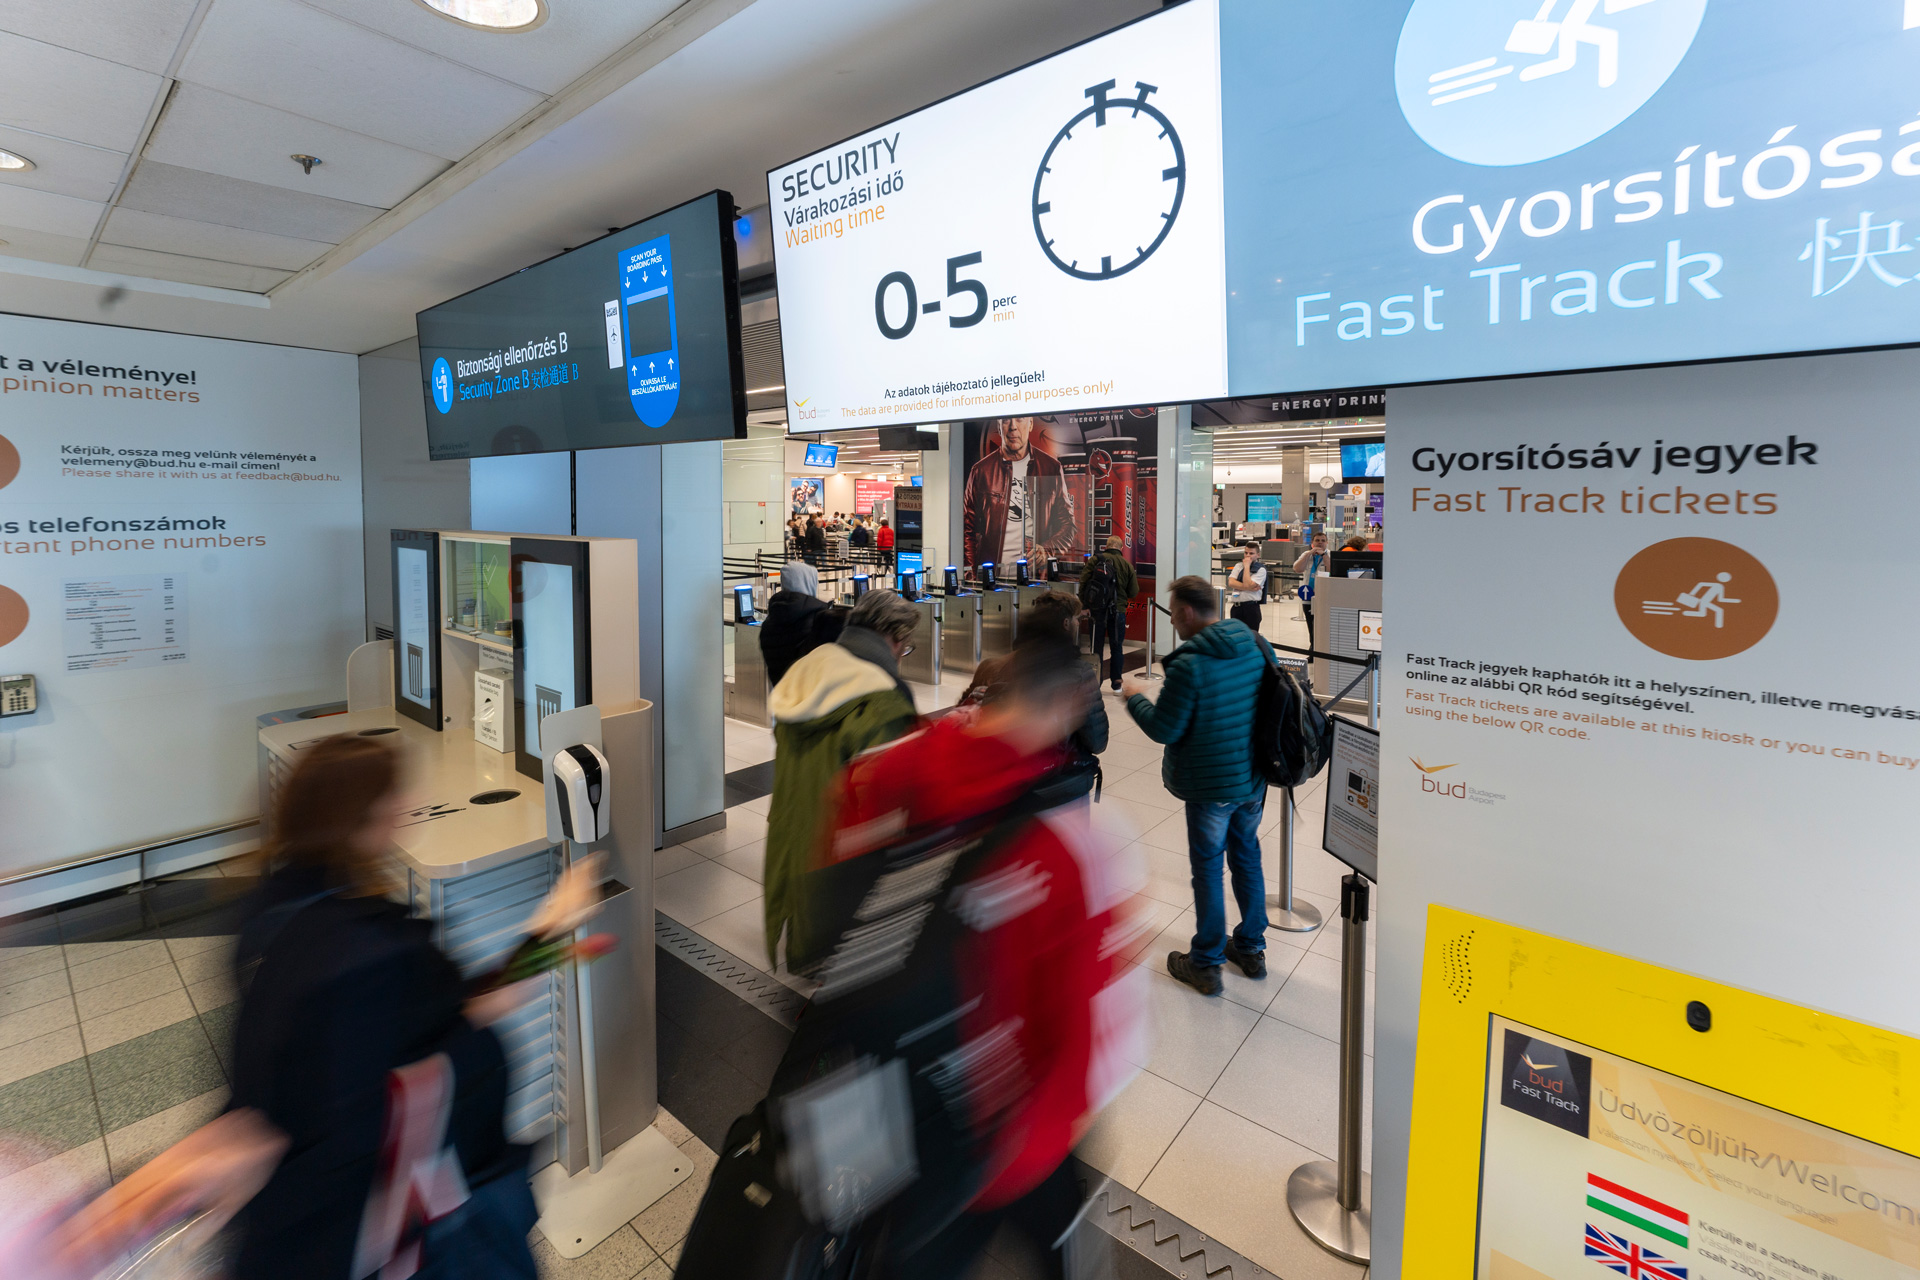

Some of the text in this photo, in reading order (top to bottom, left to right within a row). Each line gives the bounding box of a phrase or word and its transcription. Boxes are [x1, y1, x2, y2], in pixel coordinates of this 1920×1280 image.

[782, 132, 901, 202] SECURITY
[784, 170, 905, 228] Várakozási idő
[785, 203, 885, 249] Waiting time
[627, 254, 662, 273] BOARDING PASS
[630, 248, 657, 264] SCAN YOUR
[1797, 210, 1920, 298] 快
[875, 250, 989, 340] 0-5
[992, 293, 1017, 311] perc
[1295, 239, 1723, 346] Fast Track
[993, 308, 1015, 323] min
[457, 331, 568, 378] Biztonsági ellenőrzés B
[18, 359, 34, 371] a
[42, 359, 197, 386] véleménye!
[459, 363, 579, 401] Security Zone B 安检通道 B
[640, 375, 667, 387] OLVASSA LE
[884, 370, 1045, 399] Az adatok tájékoztató jellegűek!
[0, 375, 200, 403] pinion matters
[841, 407, 856, 417] The
[858, 405, 877, 416] data
[879, 404, 892, 414] are
[894, 399, 933, 414] provided
[935, 397, 949, 408] for
[951, 389, 1022, 407] informational
[1025, 385, 1079, 402] purposes
[1083, 380, 1114, 396] only!
[798, 406, 817, 420] bud
[1069, 414, 1124, 424] ENERGY DRINK
[1272, 398, 1331, 411] ENERGY
[61, 445, 115, 457] Kérjük,
[118, 448, 158, 457] ossza
[161, 450, 191, 459] meg
[194, 450, 237, 459] velünk
[240, 451, 307, 463] véleményét
[61, 457, 280, 470] velemeny@bud.hu e-mail címen!
[1411, 435, 1820, 479] Gyorsítósáv jegyek
[62, 467, 112, 478] Please
[116, 469, 155, 478] share
[158, 469, 167, 478] it
[170, 469, 198, 479] with
[220, 471, 233, 480] at
[235, 471, 343, 482] feedback@bud.hu.
[1411, 487, 1487, 513] Fast
[1498, 486, 1605, 514] Track
[1619, 486, 1779, 515] tickets
[0, 515, 226, 534] s telefonszámok
[1125, 486, 1133, 548] CLASSIC
[0, 533, 267, 556] tant phone numbers
[1406, 653, 1920, 721] Fast Track jegyek kaphatók itt a helyszínen, illetve megvás
[1406, 670, 1695, 714] online az alábbi QR kód segítségével.
[1405, 704, 1591, 741] using the below QR code.
[1406, 688, 1920, 770] Fast Track tickets are available at this kiosk or you can buy
[1422, 773, 1466, 799] bud
[1529, 1068, 1563, 1094] bud
[1512, 1079, 1580, 1115] Fast Track
[1597, 1088, 1920, 1227] Üdvözöljük/Welcom
[1706, 1167, 1743, 1190] Select
[1745, 1183, 1774, 1201] your
[1697, 1247, 1728, 1266] csak
[1698, 1219, 1743, 1246] Kerülje
[1745, 1240, 1757, 1252] el
[1759, 1246, 1768, 1256] a
[1770, 1251, 1819, 1278] sorban
